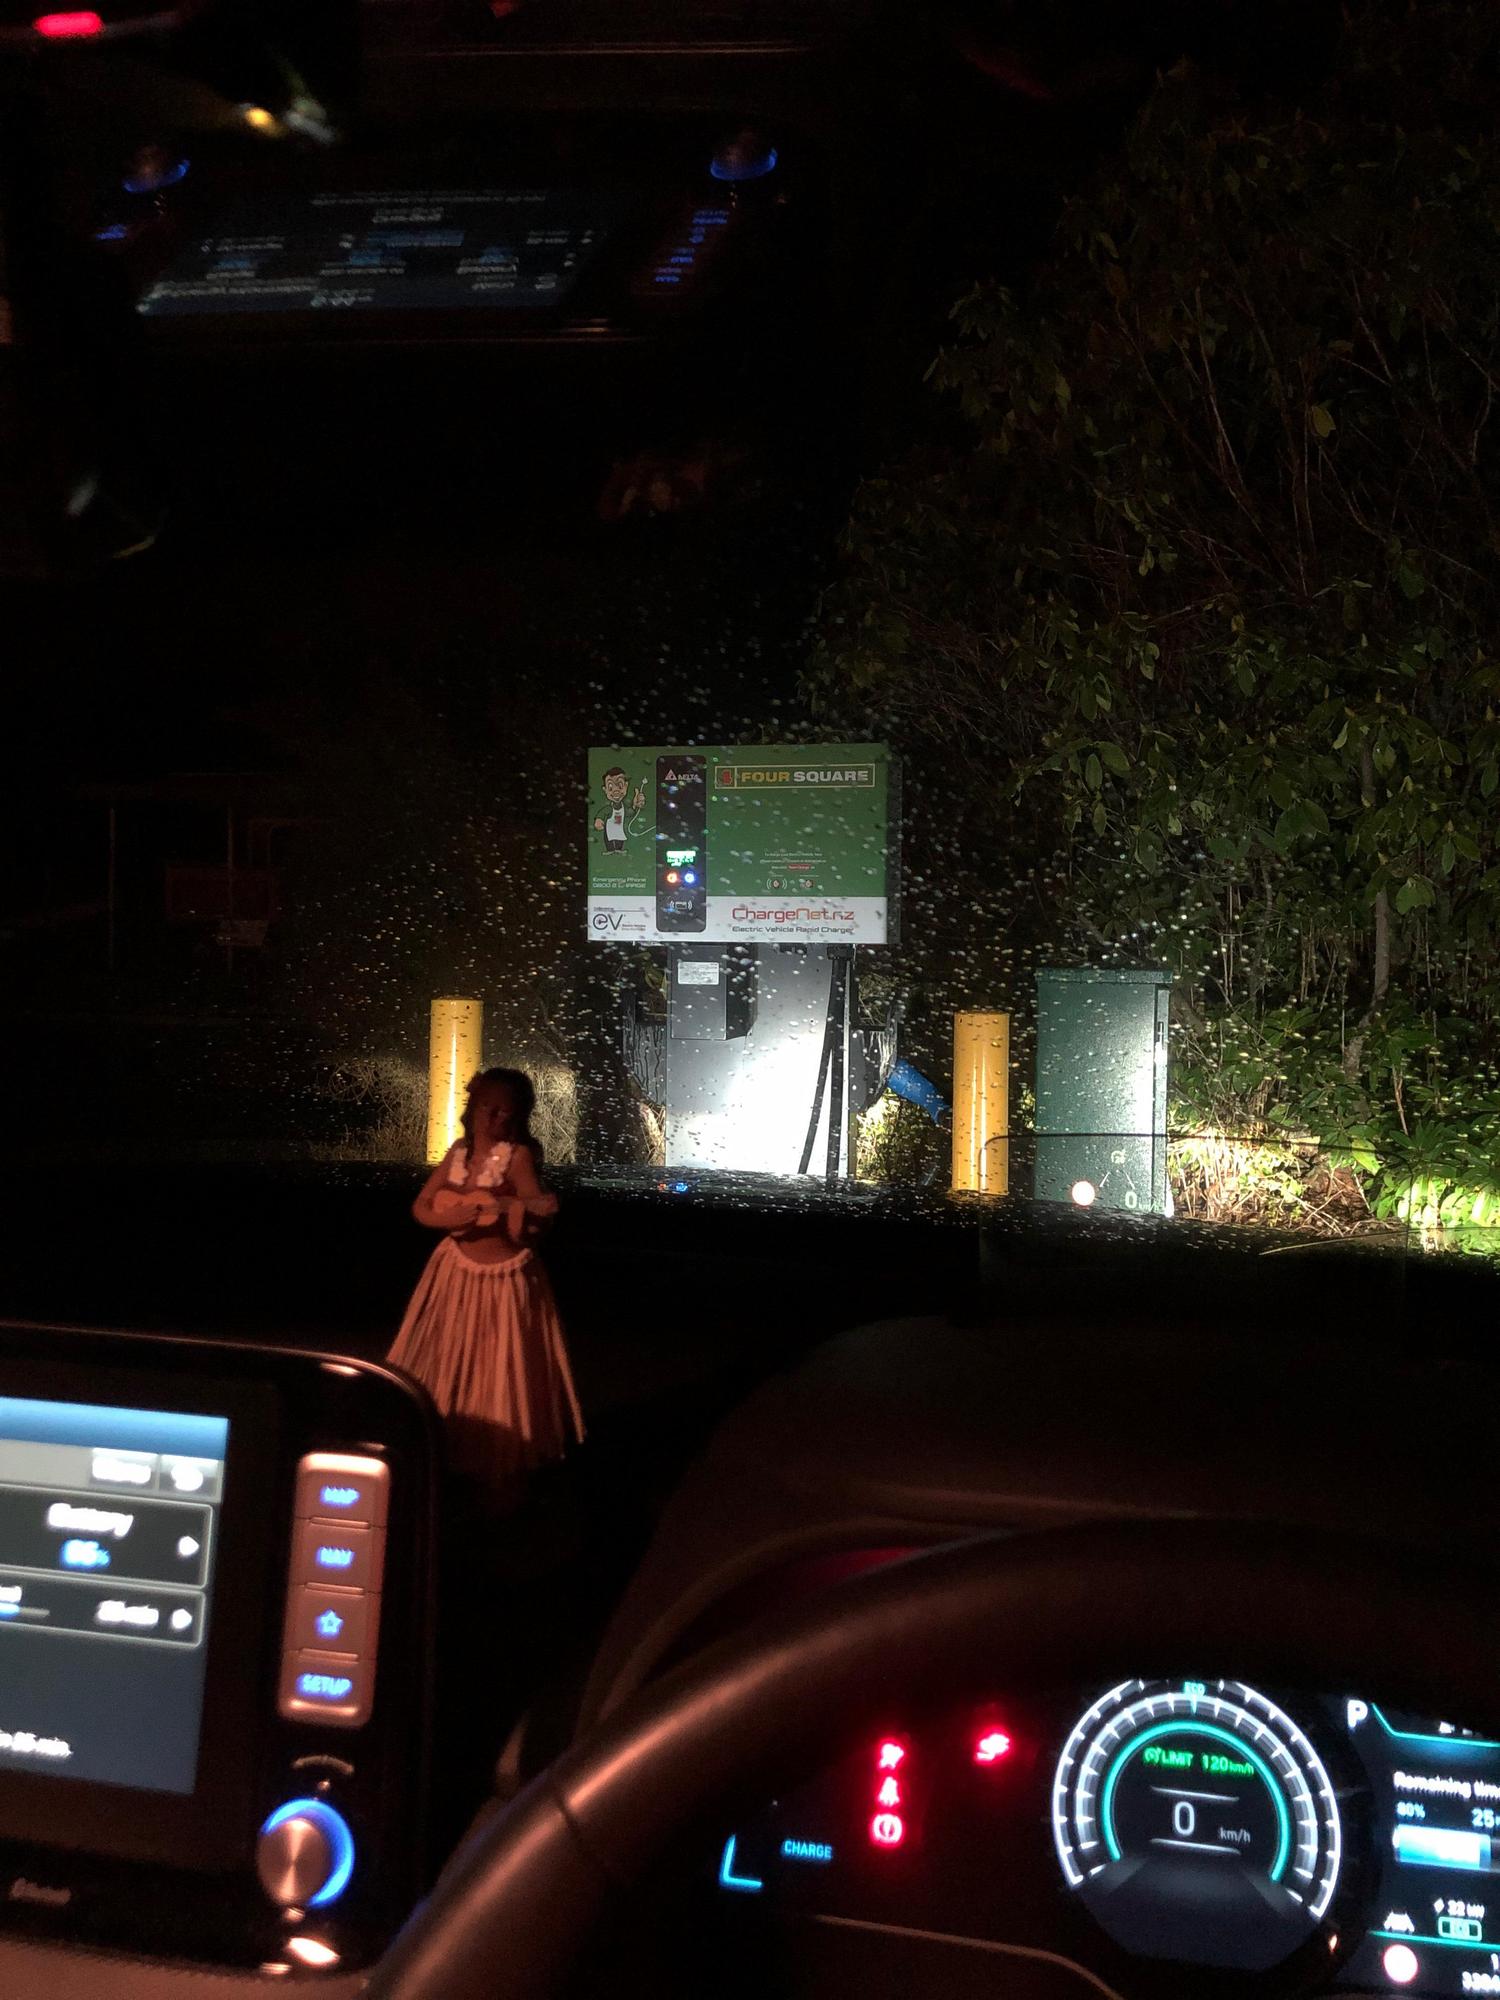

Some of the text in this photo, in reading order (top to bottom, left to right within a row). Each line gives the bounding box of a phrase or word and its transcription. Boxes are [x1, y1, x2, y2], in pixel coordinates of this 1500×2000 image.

[741, 770, 869, 783] FOUR SQUARE
[732, 905, 855, 923] ChargeNet.nz
[796, 926, 820, 935] Rapid
[298, 1674, 353, 1696] SETUP
[1184, 1682, 1205, 1696] ECO
[1347, 1699, 1368, 1729] P
[1162, 1752, 1193, 1767] LIMIT
[1174, 1801, 1195, 1836] 0
[1219, 1827, 1251, 1842] km/h
[783, 1839, 833, 1860] CHARGE
